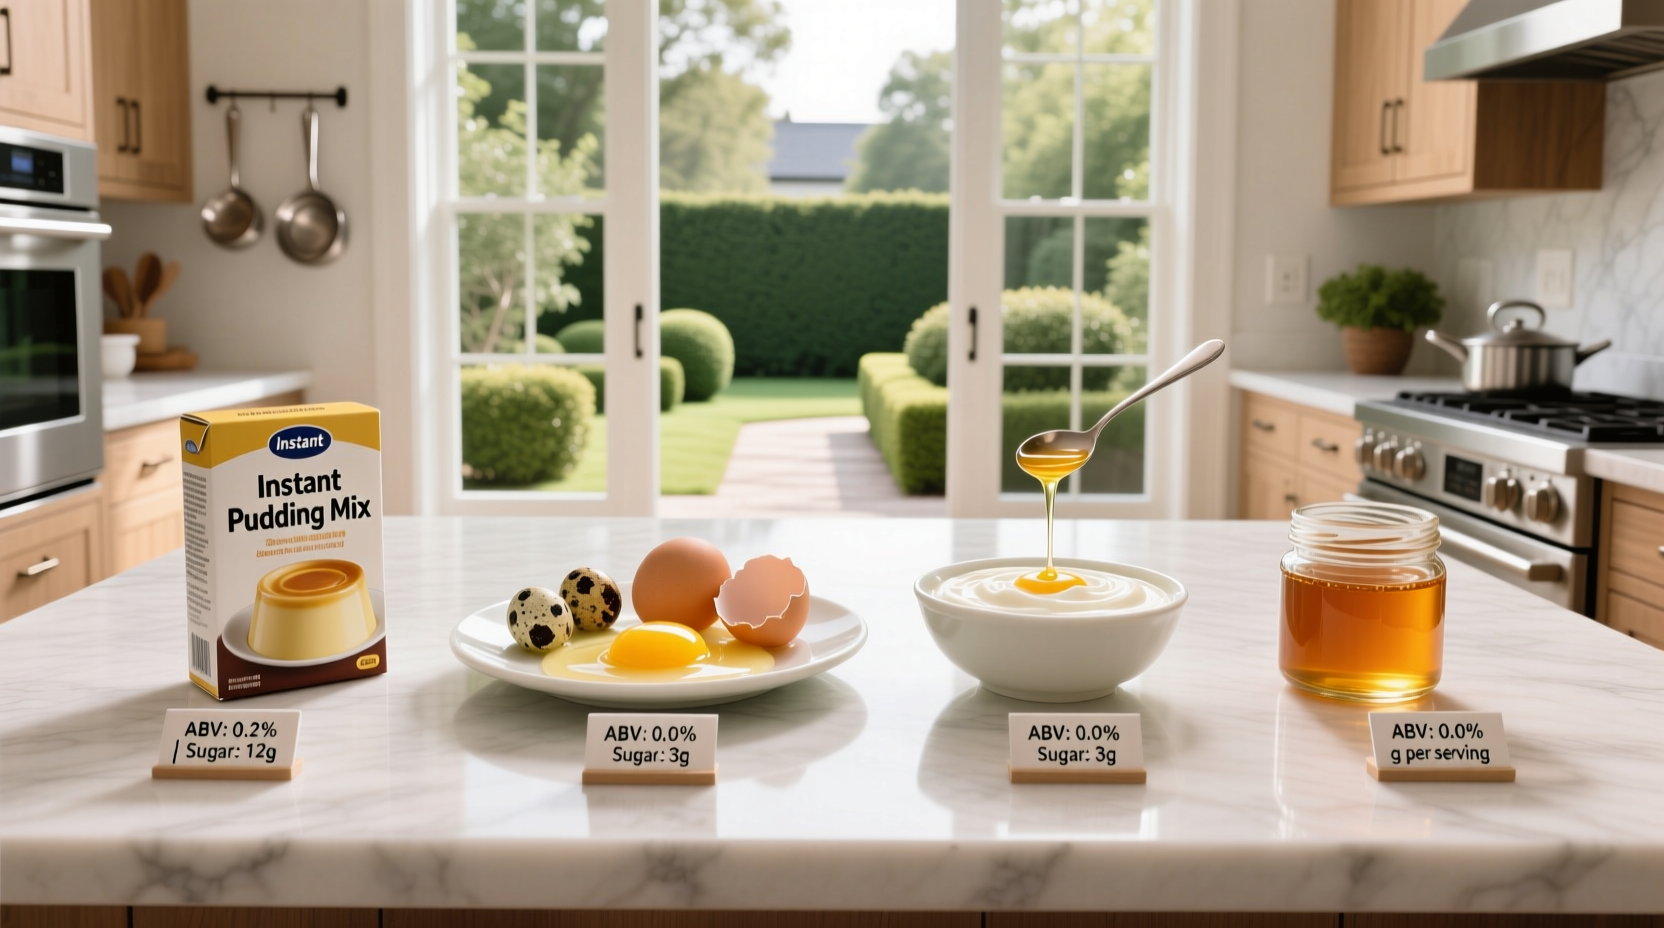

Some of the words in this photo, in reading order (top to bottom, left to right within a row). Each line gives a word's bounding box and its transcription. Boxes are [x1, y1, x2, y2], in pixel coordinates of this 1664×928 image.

[276, 433, 324, 451] Instant
[257, 469, 342, 498] Instant
[227, 502, 325, 533] Pudding
[330, 495, 371, 521] Mix
[184, 721, 228, 737] ABV:
[232, 721, 277, 738] 0.2%
[604, 725, 647, 742] ABV:
[651, 725, 697, 742] 0.0%
[1028, 724, 1070, 741] ABV:
[1075, 724, 1120, 741] 0.0%
[1392, 723, 1434, 739] ABV:
[1438, 723, 1484, 739] 0.0%
[186, 742, 241, 762] Sugar:
[246, 742, 277, 763] 12g
[612, 746, 665, 766] Sugar:
[669, 747, 690, 767] 3g
[1037, 746, 1091, 766] Sugar:
[1095, 746, 1117, 766] 3g
[1391, 748, 1402, 764] g
[1406, 748, 1431, 765] per
[1434, 744, 1490, 764] serving
